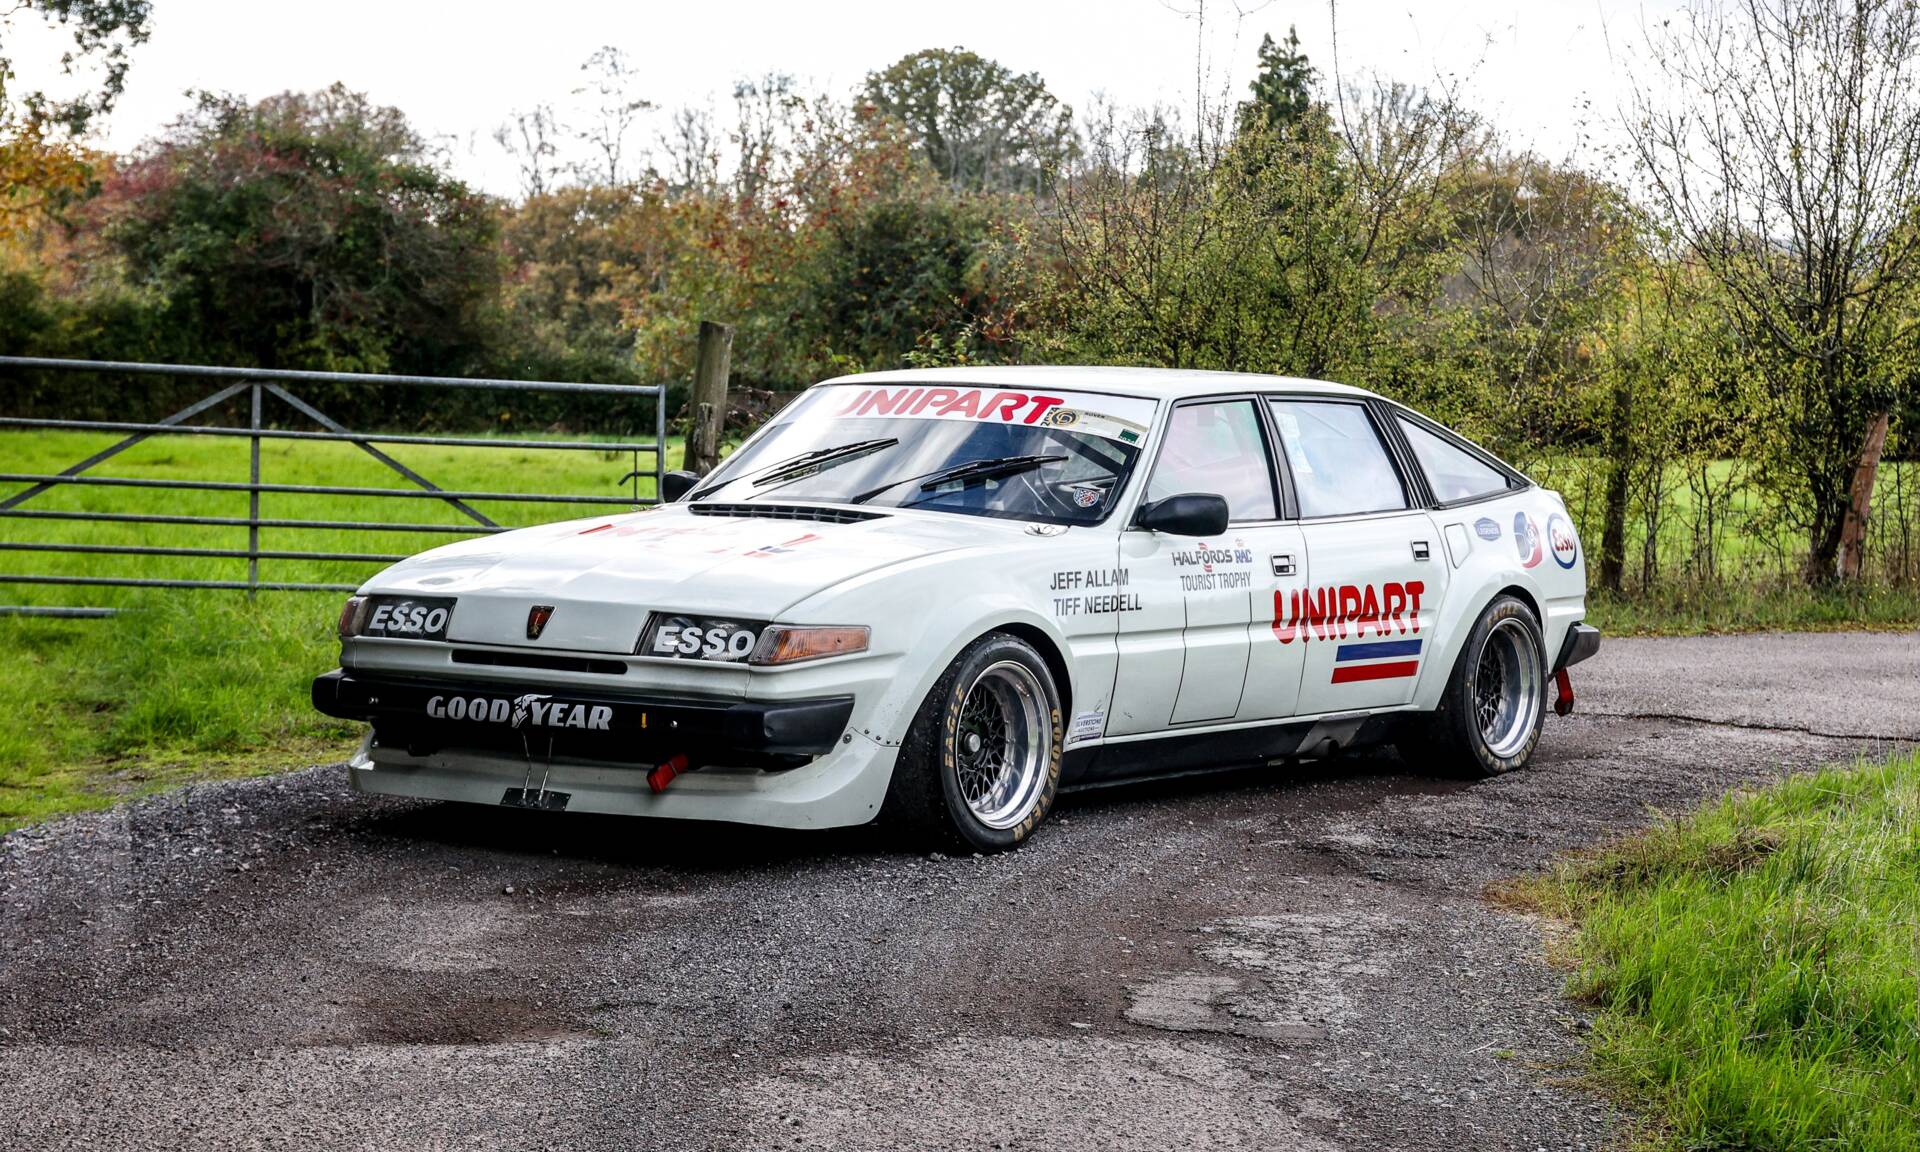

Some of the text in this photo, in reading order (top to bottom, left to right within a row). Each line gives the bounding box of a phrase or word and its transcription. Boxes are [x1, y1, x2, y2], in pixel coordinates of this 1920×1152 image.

[1552, 528, 1574, 552] Esso
[1171, 550, 1253, 566] HALFORDS RAC
[1050, 568, 1129, 590] JEFF ALLAM
[1180, 571, 1251, 592] TOURIST TROPHY
[1054, 593, 1143, 617] TIFF NEEDELL
[1271, 581, 1424, 644] UNIPART
[368, 603, 448, 634] ESSO
[653, 625, 756, 659] ESSO
[943, 683, 966, 769] EAGLE
